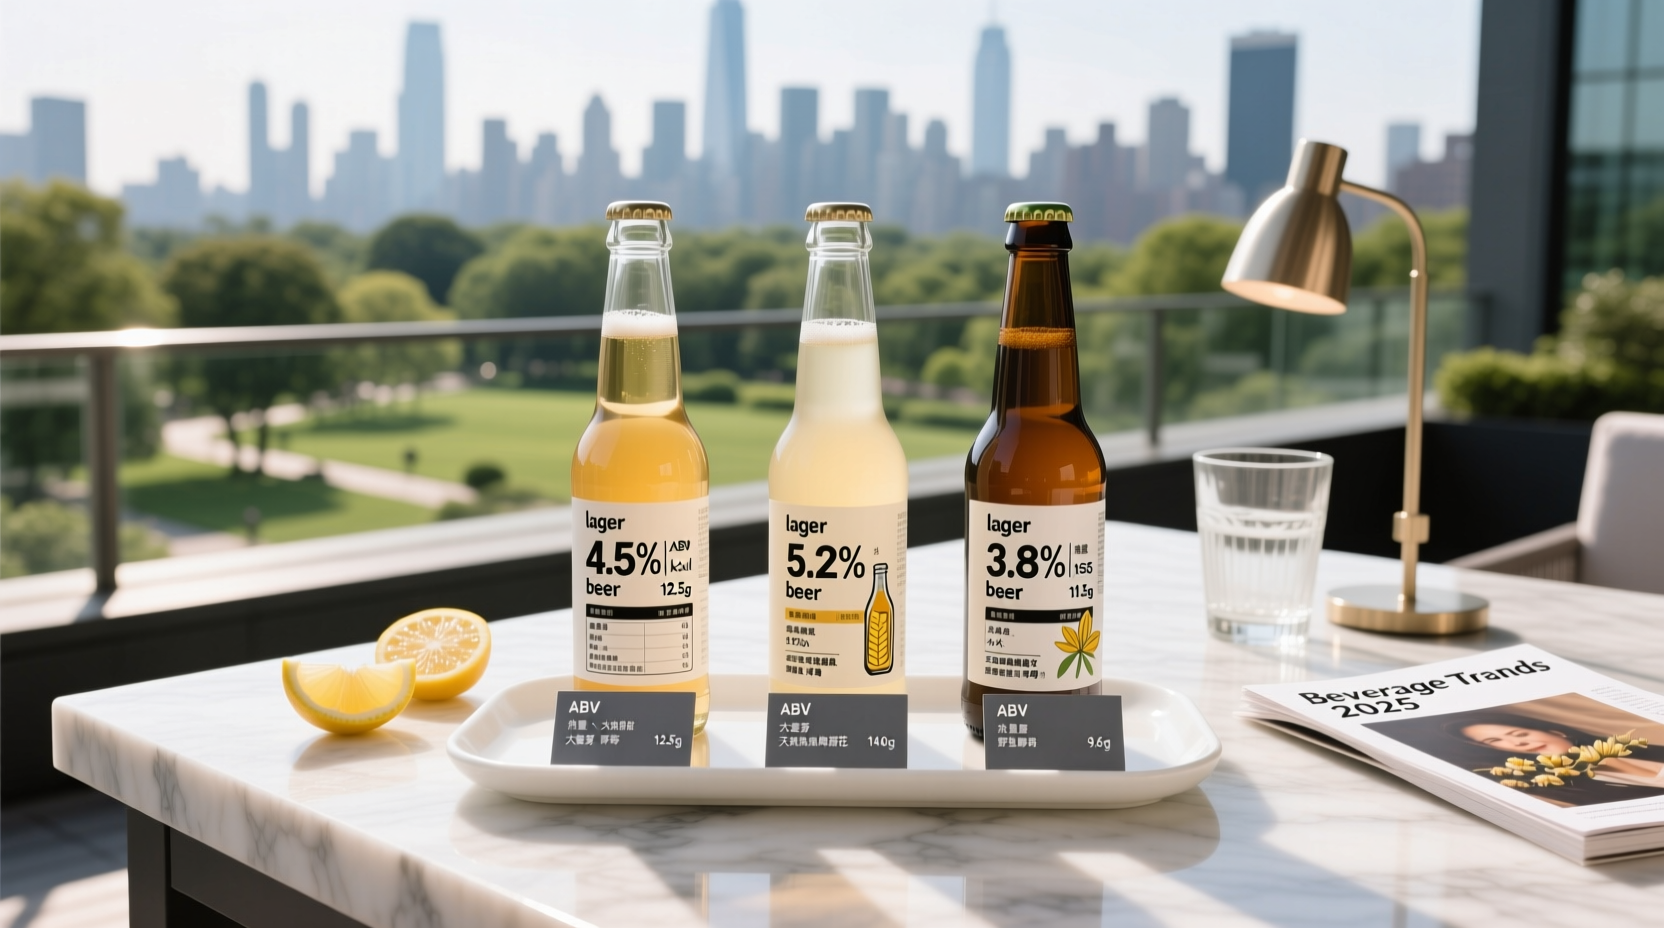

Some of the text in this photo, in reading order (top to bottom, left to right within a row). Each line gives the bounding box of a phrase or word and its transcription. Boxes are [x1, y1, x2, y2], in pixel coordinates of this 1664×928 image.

[586, 510, 625, 534] lager
[786, 514, 828, 538] lager
[987, 513, 1031, 537] lager
[586, 540, 661, 576] 4.5%
[786, 543, 865, 579] 5.2%
[986, 543, 1065, 579] 3.8%
[586, 577, 621, 597] beer
[786, 580, 822, 601] beer
[986, 580, 1023, 600] beer
[1298, 660, 1551, 705] Beverage Trands
[568, 700, 601, 714] ABV
[780, 702, 811, 716] ABV
[997, 703, 1028, 717] ABV
[1331, 697, 1420, 718] 2025
